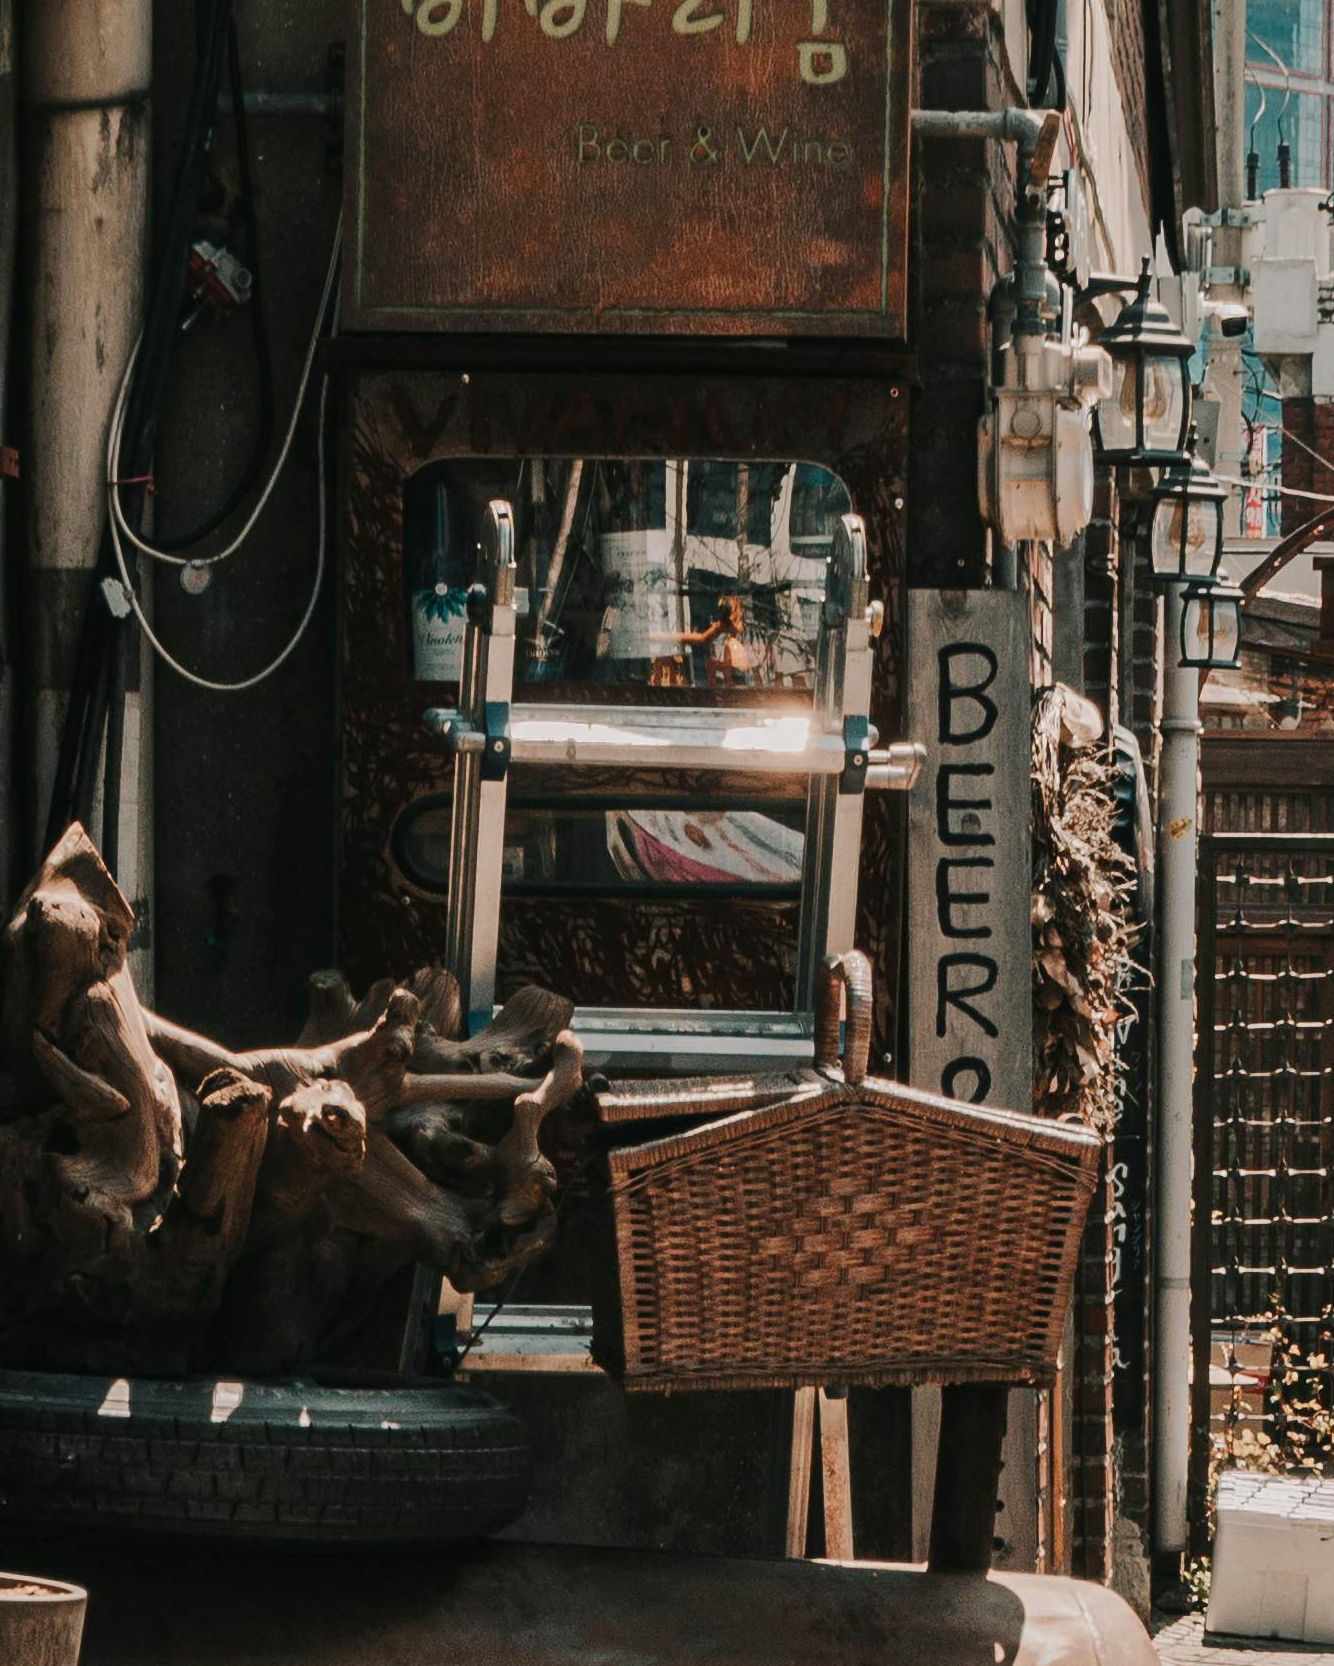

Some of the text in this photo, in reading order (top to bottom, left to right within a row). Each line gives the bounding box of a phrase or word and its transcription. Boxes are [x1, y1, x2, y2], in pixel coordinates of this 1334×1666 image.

[576, 123, 851, 165] Beer & Wine
